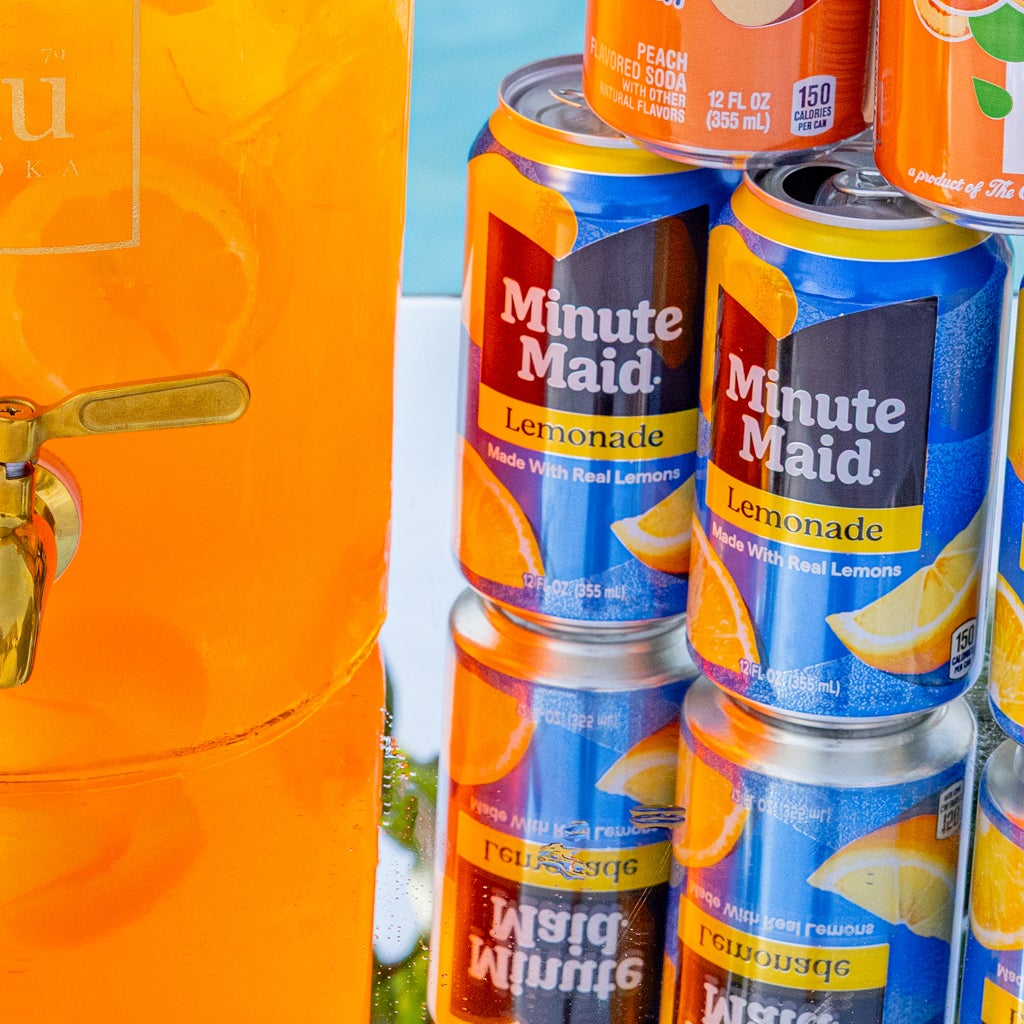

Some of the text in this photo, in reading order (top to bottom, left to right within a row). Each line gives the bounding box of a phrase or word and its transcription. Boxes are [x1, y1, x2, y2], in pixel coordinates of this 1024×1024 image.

[590, 36, 687, 93] FLAVORED SODA
[637, 41, 688, 72] PEACH
[599, 80, 686, 123] NATURAL FLAVORS
[622, 77, 686, 107] WITH OTHER
[708, 90, 772, 110] 12 FL OZ
[798, 82, 831, 108] 150
[706, 109, 770, 134] (355 mL)
[794, 106, 832, 121] CALORIES
[798, 119, 827, 131] PER CAN
[908, 167, 916, 177] a
[913, 170, 965, 192] product
[965, 180, 984, 199] of
[985, 178, 1015, 199] The
[500, 276, 683, 344] Minute
[725, 352, 906, 434] Minute
[505, 406, 664, 449] Lemonade
[487, 442, 681, 486] Made With Real Lemons
[727, 485, 884, 542] Lemonade
[711, 521, 902, 579] Made With Real Lemons
[956, 624, 975, 653] 150
[739, 658, 750, 676] 12
[787, 673, 815, 692] (355
[818, 679, 840, 698] mL)
